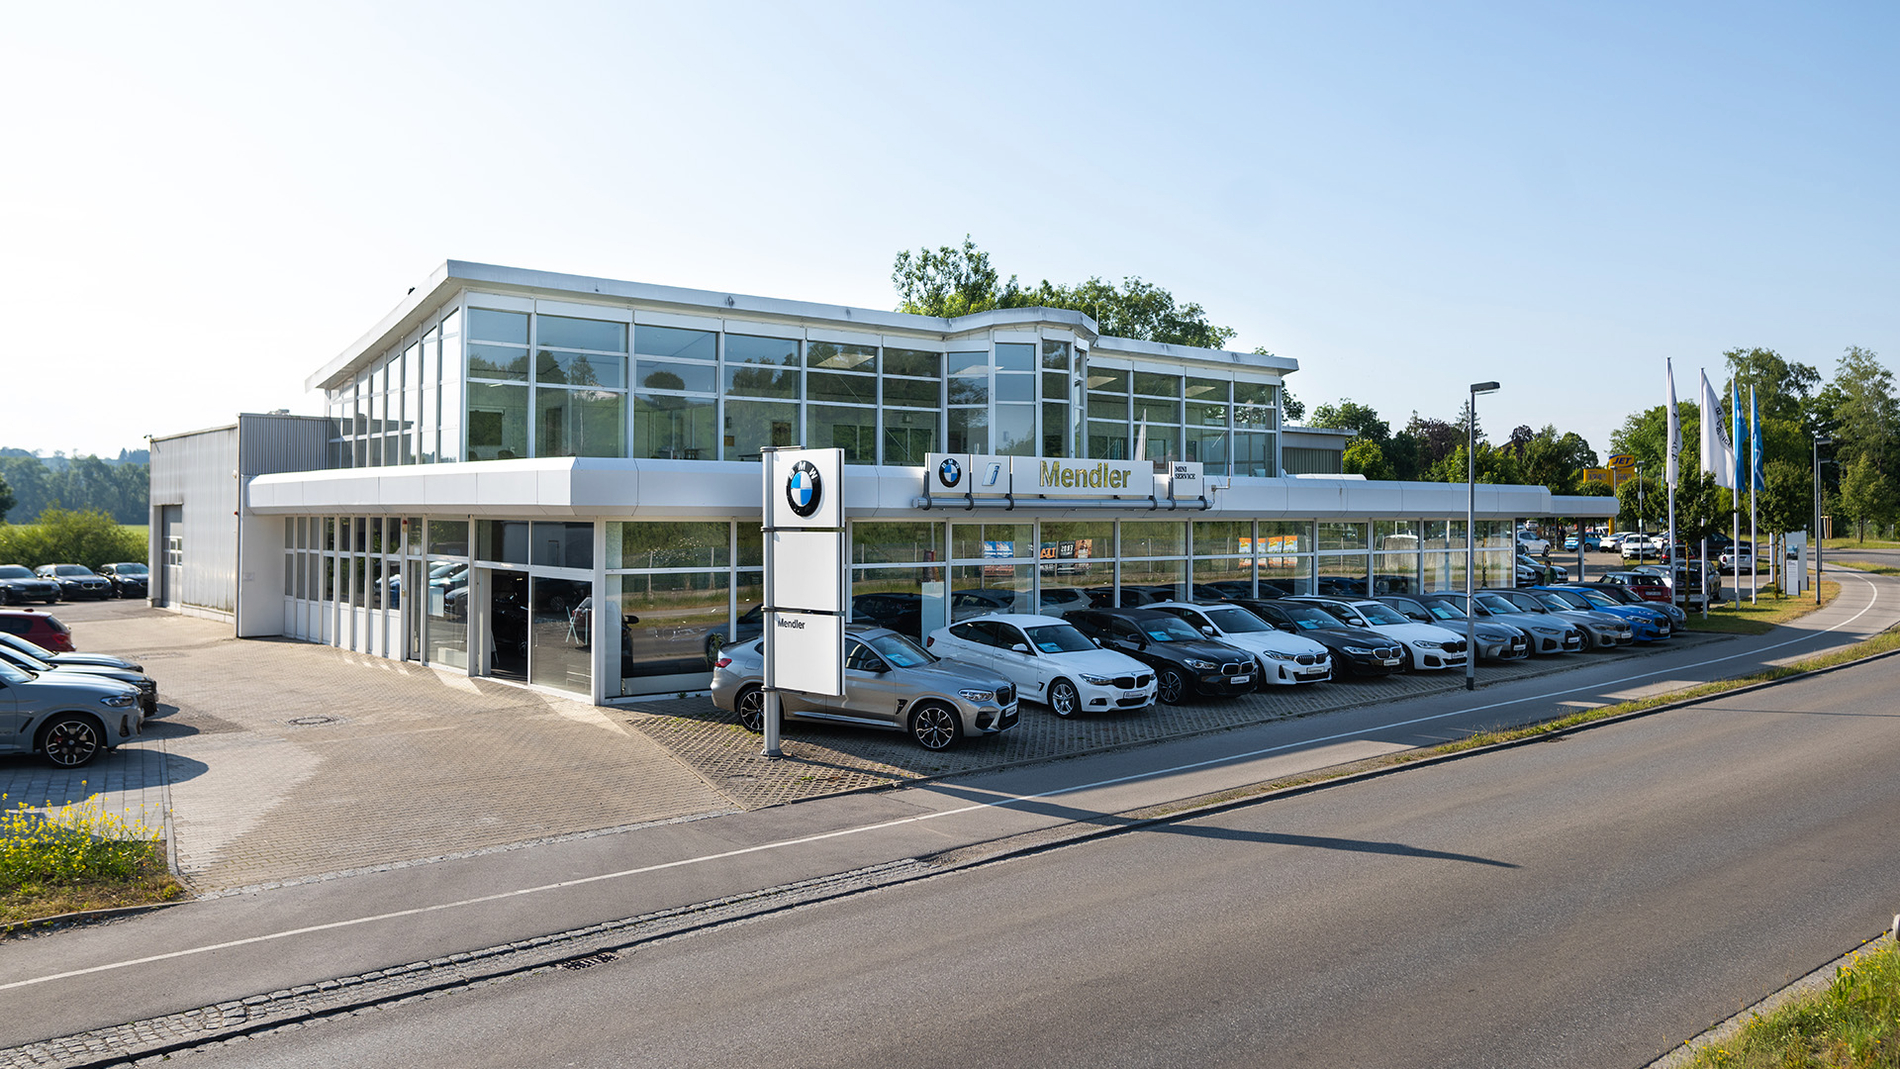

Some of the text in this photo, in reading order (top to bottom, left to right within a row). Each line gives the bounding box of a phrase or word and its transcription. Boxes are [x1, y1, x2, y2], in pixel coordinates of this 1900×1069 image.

[941, 459, 960, 469] BMW
[1613, 457, 1632, 465] JET
[789, 461, 818, 480] BMW
[1039, 460, 1131, 488] Mendler
[777, 617, 806, 629] Mendler
